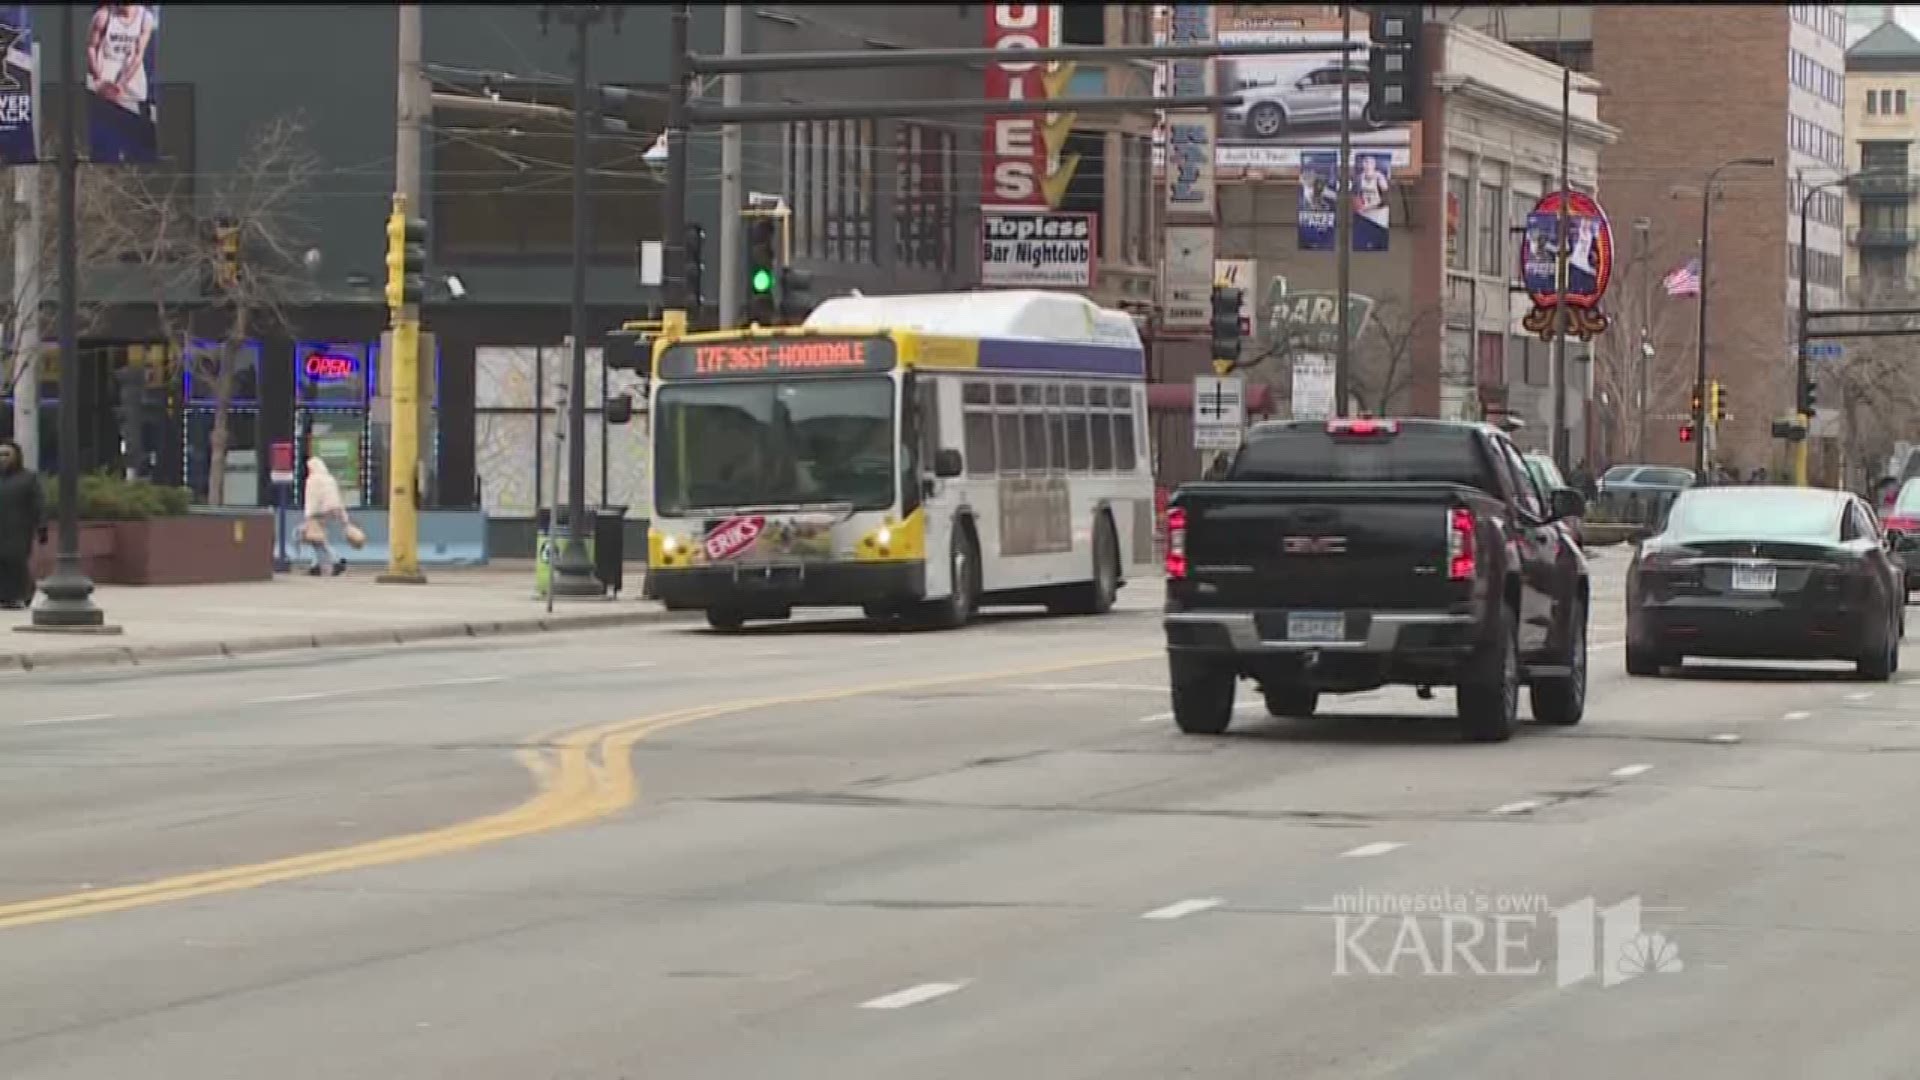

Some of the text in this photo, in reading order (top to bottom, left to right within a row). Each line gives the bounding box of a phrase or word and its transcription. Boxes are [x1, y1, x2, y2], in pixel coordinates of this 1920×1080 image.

[984, 216, 1087, 239] Topless
[983, 241, 1088, 268] Bar Nightclub
[306, 356, 351, 375] OPEN
